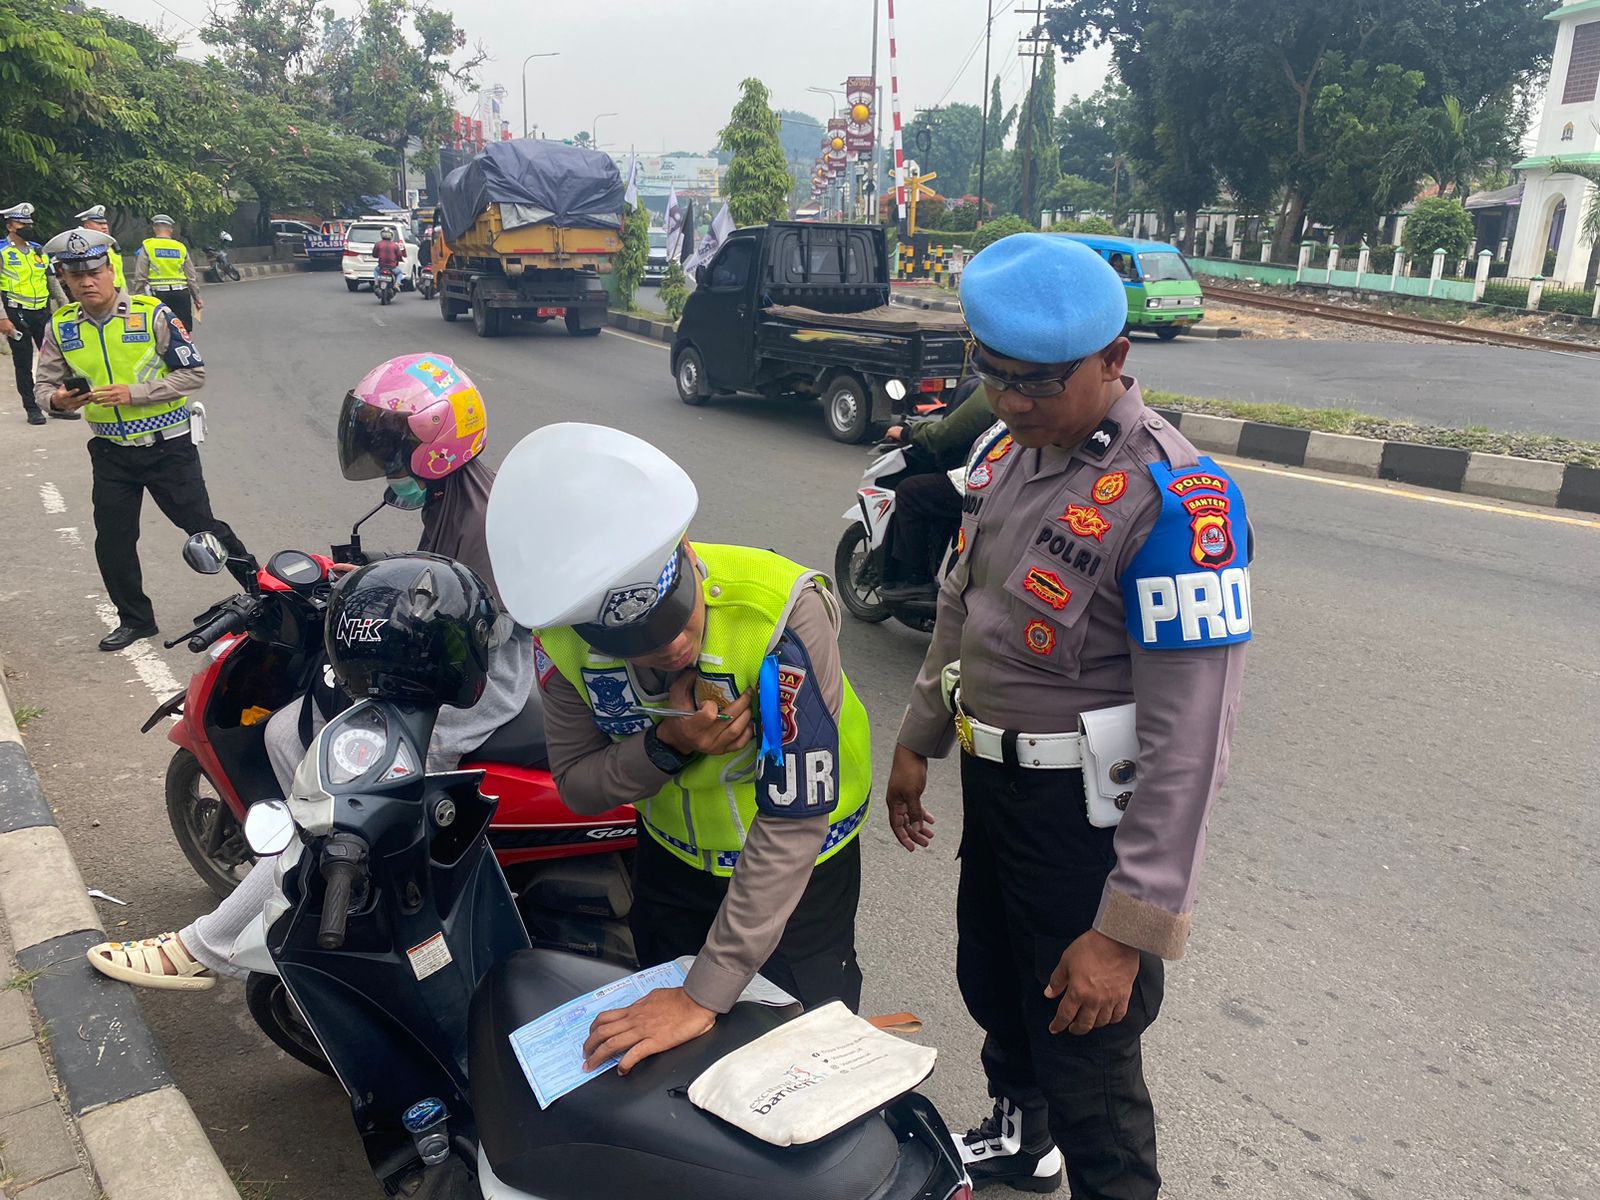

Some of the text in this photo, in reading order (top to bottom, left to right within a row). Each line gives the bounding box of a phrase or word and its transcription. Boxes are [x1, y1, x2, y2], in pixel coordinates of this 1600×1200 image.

[156, 249, 181, 258] POLISI
[310, 240, 344, 248] POLISI
[124, 334, 148, 343] POLRI
[1175, 476, 1222, 492] POLDA
[1188, 497, 1226, 510] BANTEN
[1035, 527, 1101, 577] POLRI
[1136, 567, 1252, 643] PRO
[336, 611, 389, 648] NHK
[757, 750, 835, 805] JR
[752, 1077, 819, 1115] banten
